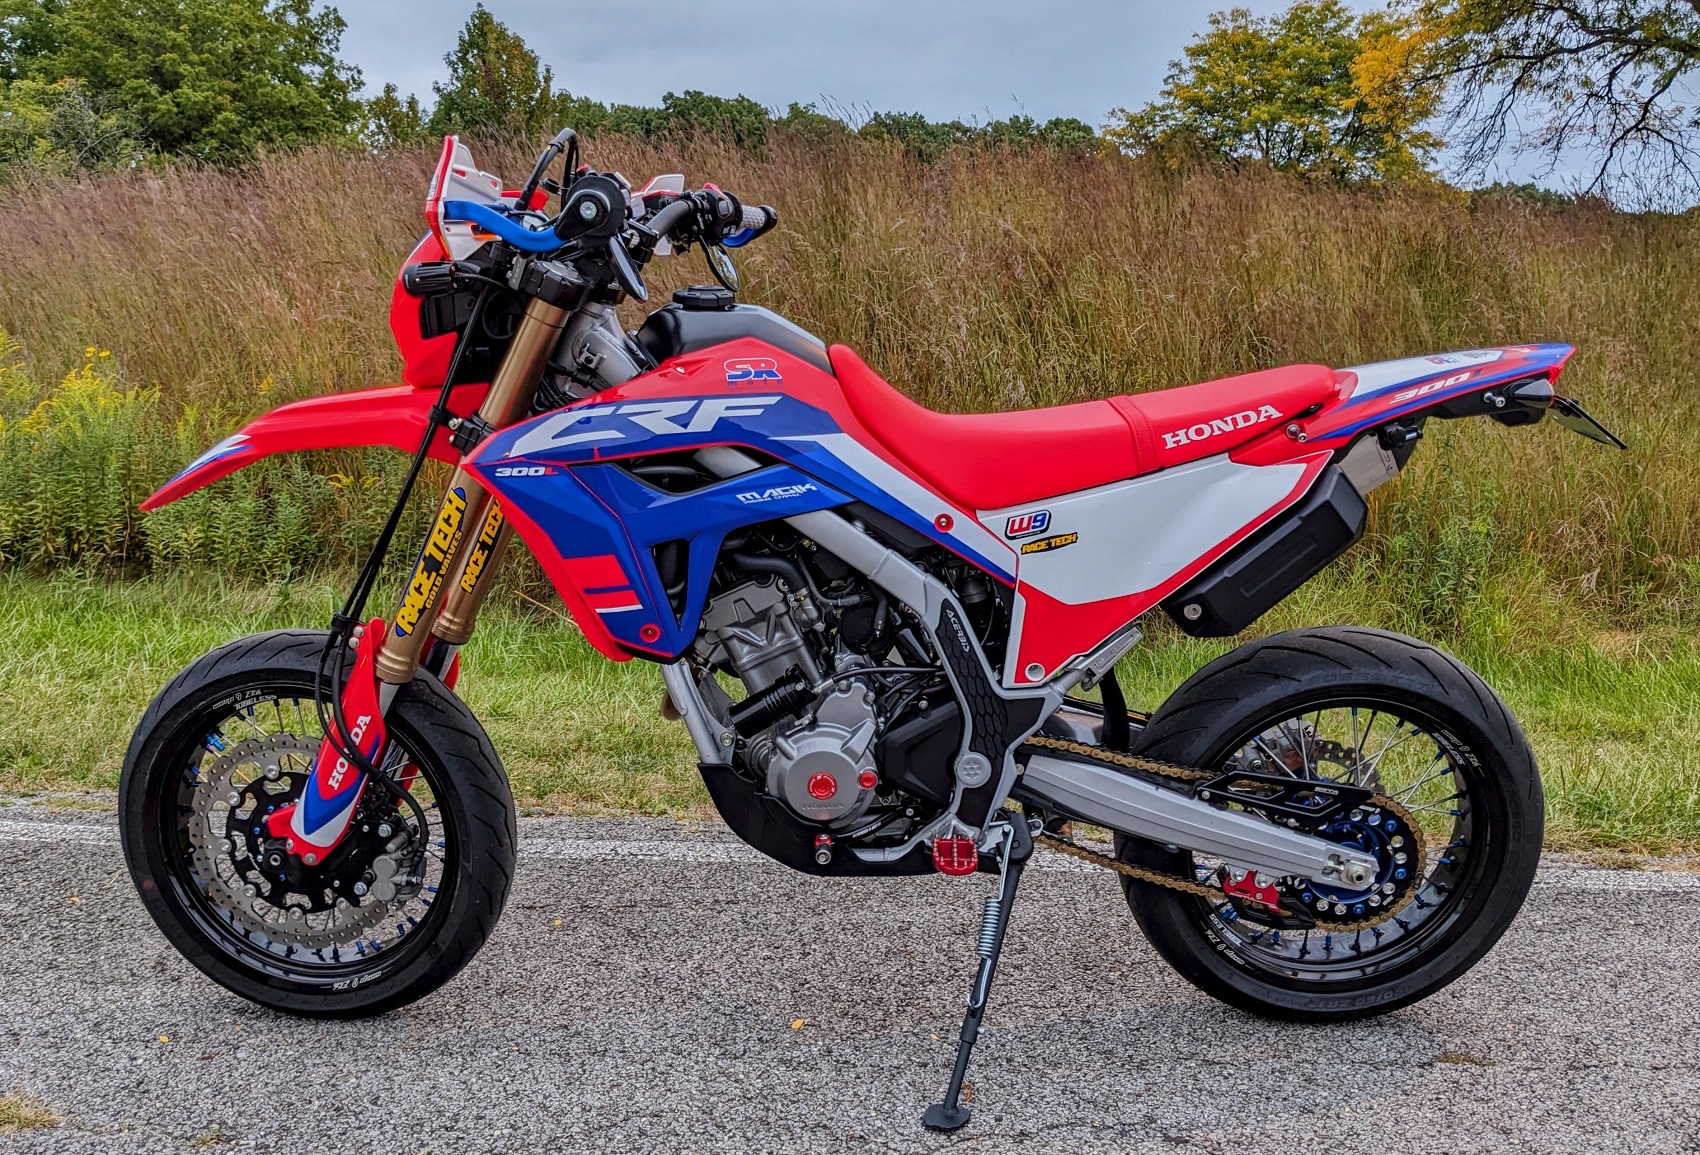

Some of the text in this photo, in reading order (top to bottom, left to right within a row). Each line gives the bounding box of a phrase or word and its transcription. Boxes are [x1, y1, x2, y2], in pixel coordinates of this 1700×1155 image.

[723, 357, 783, 381] SR
[509, 396, 783, 458] CRF
[1161, 404, 1284, 449] HONDA
[494, 467, 559, 477] 300L
[735, 483, 818, 503] MAGIK
[395, 487, 469, 635] RACE TECH
[1021, 540, 1049, 554] RACE
[1049, 533, 1077, 548] TECH
[425, 530, 464, 609] GOLD VALVES
[460, 542, 488, 595] RACE
[233, 694, 277, 710] TUBELESS
[327, 715, 372, 791] HODA
